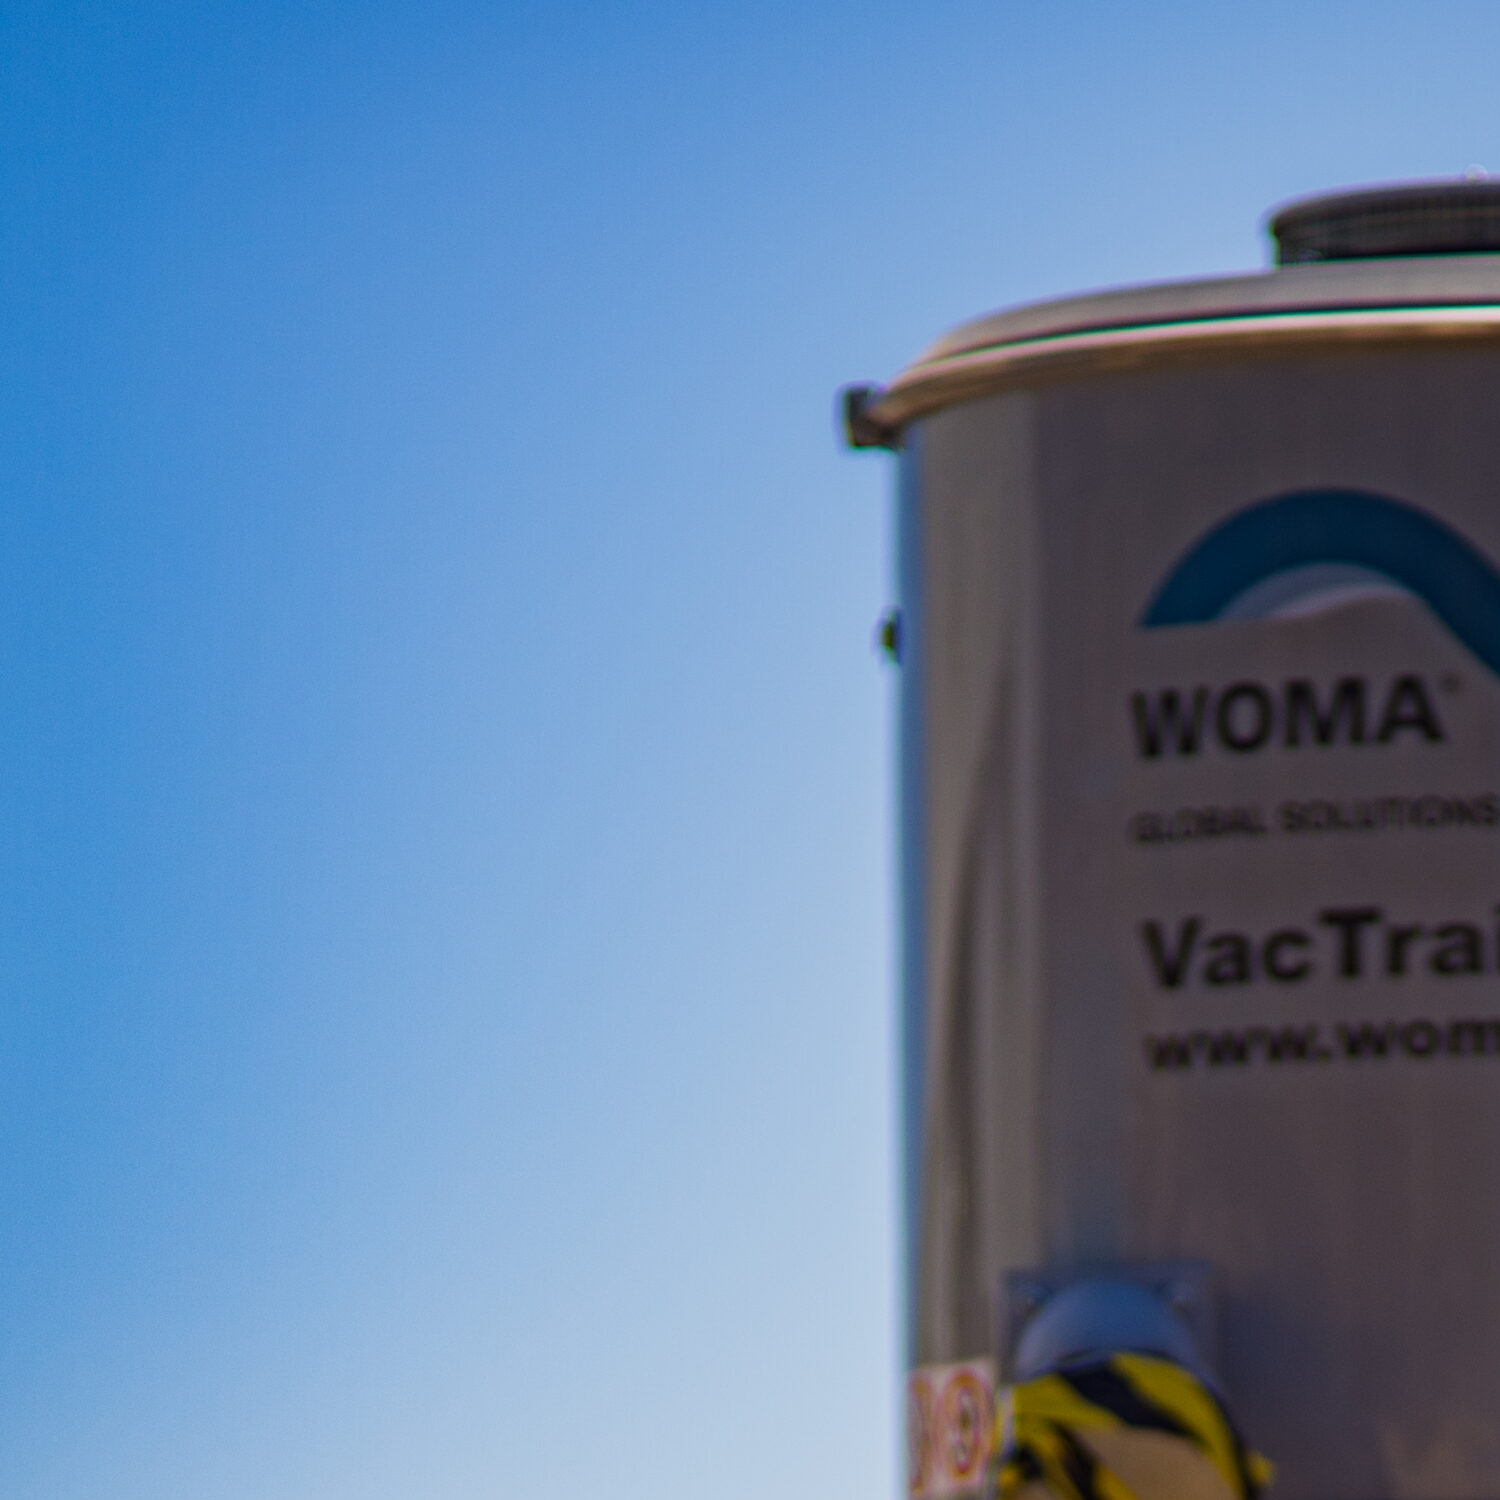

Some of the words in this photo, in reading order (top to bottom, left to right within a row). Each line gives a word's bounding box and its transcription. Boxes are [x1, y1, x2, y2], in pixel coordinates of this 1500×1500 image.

[1131, 673, 1446, 760] WOMA
[1130, 810, 1268, 844] GLOBAL
[1281, 795, 1500, 832] SOLUTIONS
